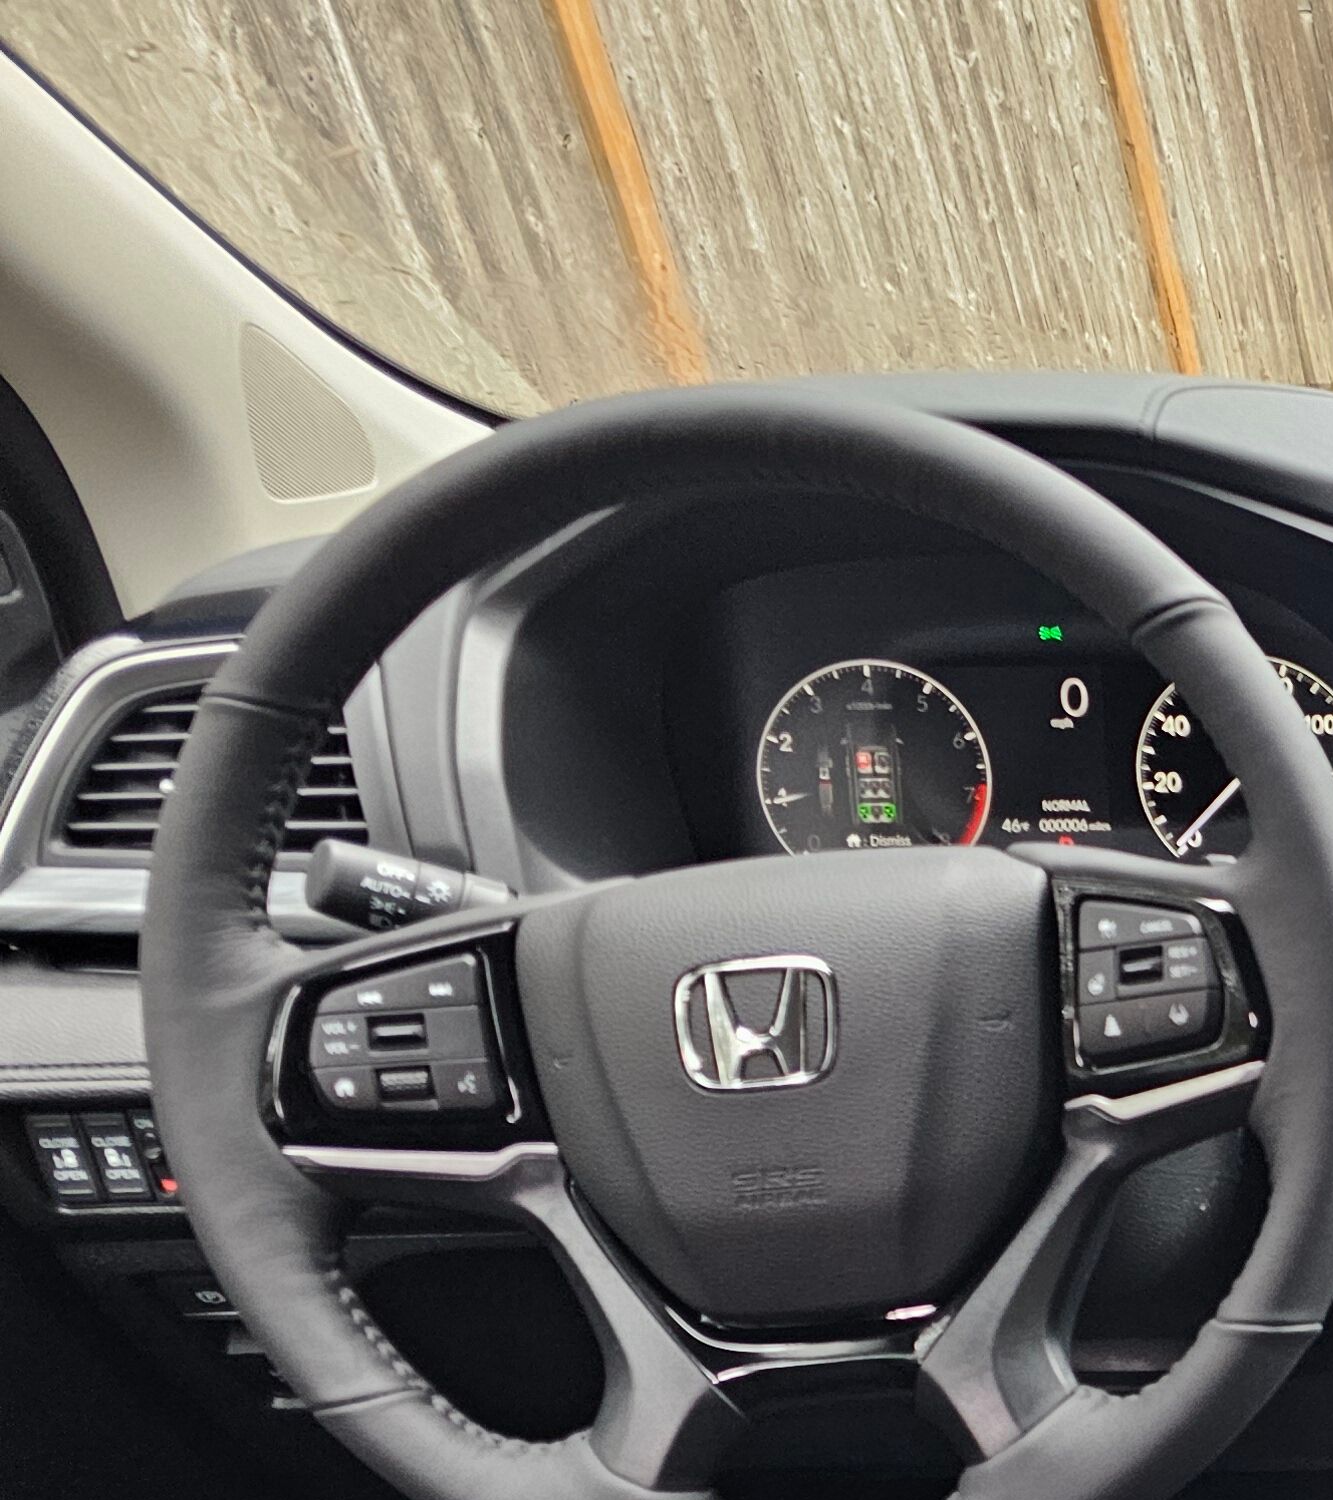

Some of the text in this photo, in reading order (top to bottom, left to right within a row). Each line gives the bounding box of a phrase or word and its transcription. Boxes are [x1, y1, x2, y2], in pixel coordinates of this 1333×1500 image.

[861, 679, 874, 696] 4
[810, 697, 823, 714] 3
[917, 694, 929, 713] 5
[1060, 677, 1089, 718] 0
[1161, 714, 1191, 737] 40
[778, 731, 793, 753] 2
[952, 732, 966, 749] 6
[1153, 771, 1183, 794] 20
[1041, 799, 1091, 813] NORMAL
[1039, 818, 1089, 833] 000006
[869, 834, 912, 848] Dismiss
[53, 1169, 89, 1181] OPEN
[105, 1168, 141, 1180] OPEN
